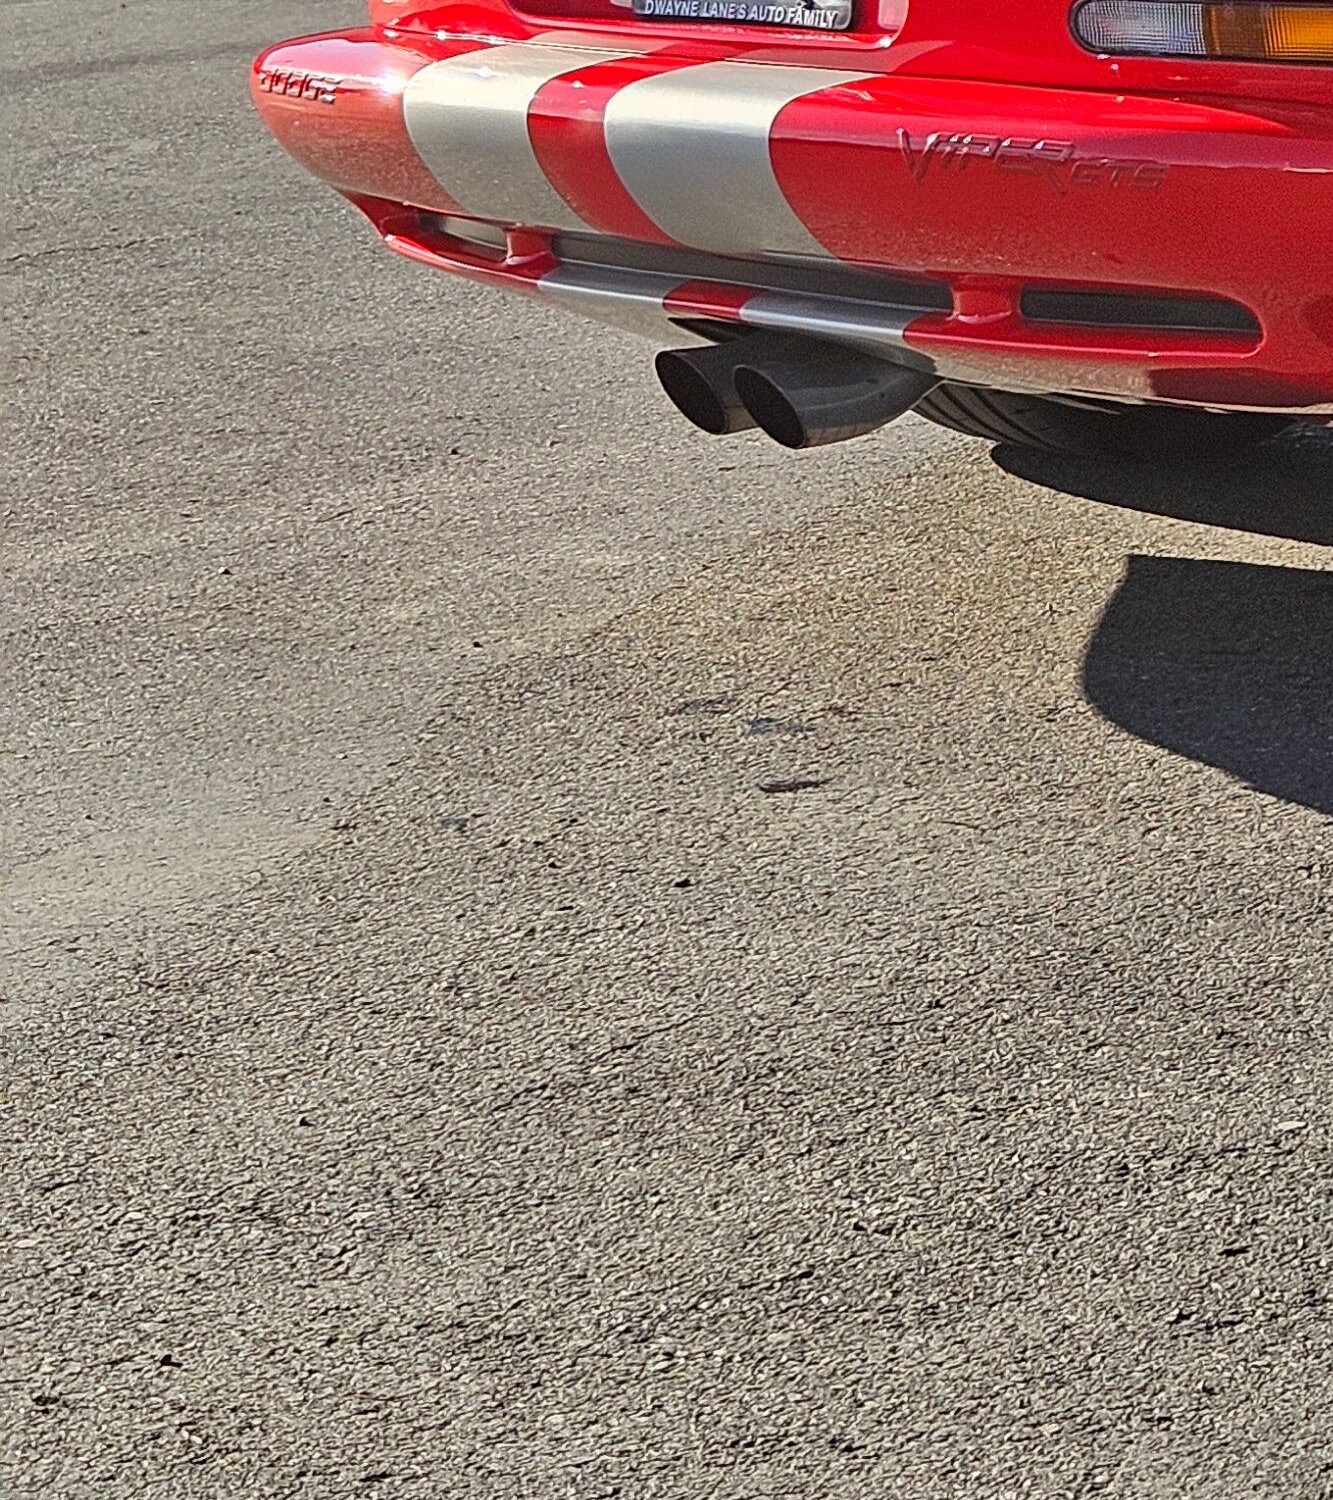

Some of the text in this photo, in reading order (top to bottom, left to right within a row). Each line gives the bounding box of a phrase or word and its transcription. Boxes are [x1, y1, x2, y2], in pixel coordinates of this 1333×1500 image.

[645, 0, 839, 28] DWAYNE LANE'S AUTO FAMILY
[896, 126, 1170, 195] VIPER GTS
